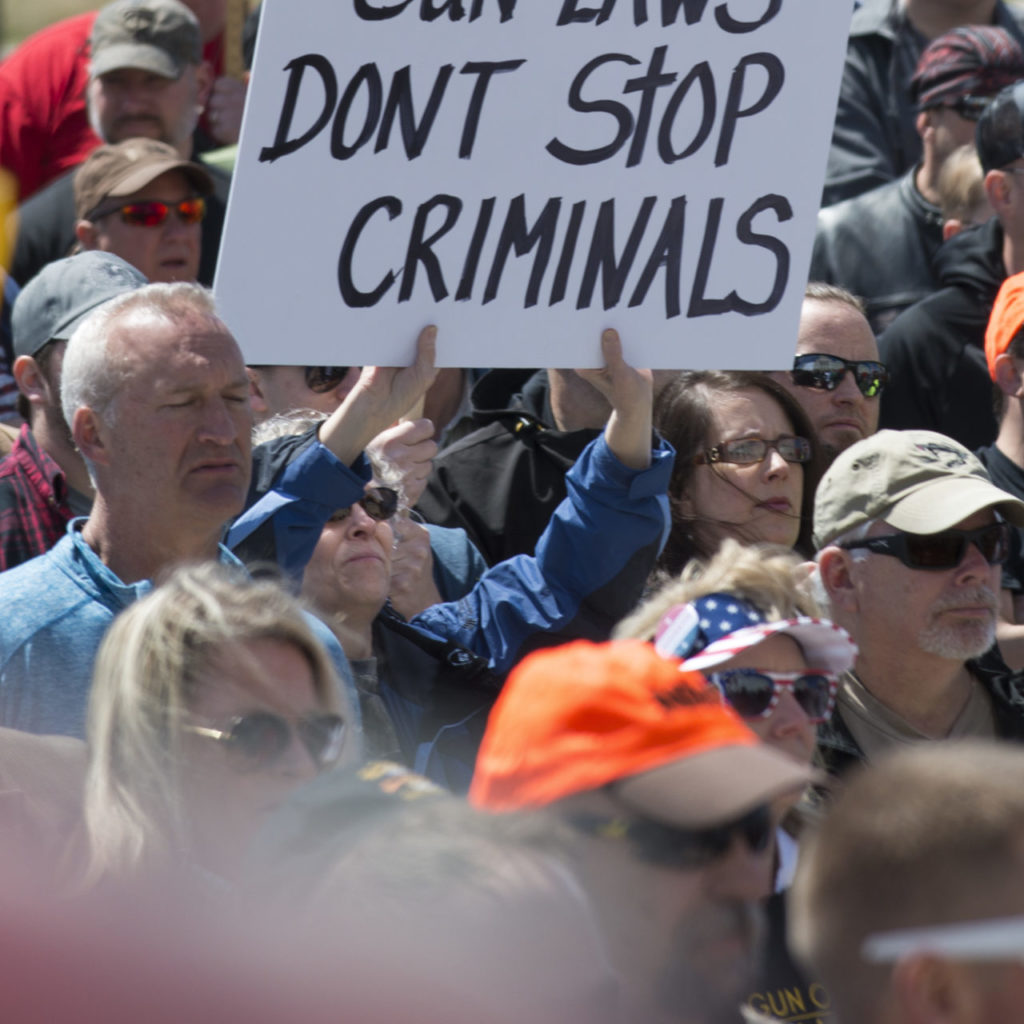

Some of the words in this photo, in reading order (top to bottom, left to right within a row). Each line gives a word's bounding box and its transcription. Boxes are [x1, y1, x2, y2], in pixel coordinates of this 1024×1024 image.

[258, 52, 528, 163] DONT
[336, 192, 794, 319] CRIMINALS
[747, 985, 807, 1017] GUN
